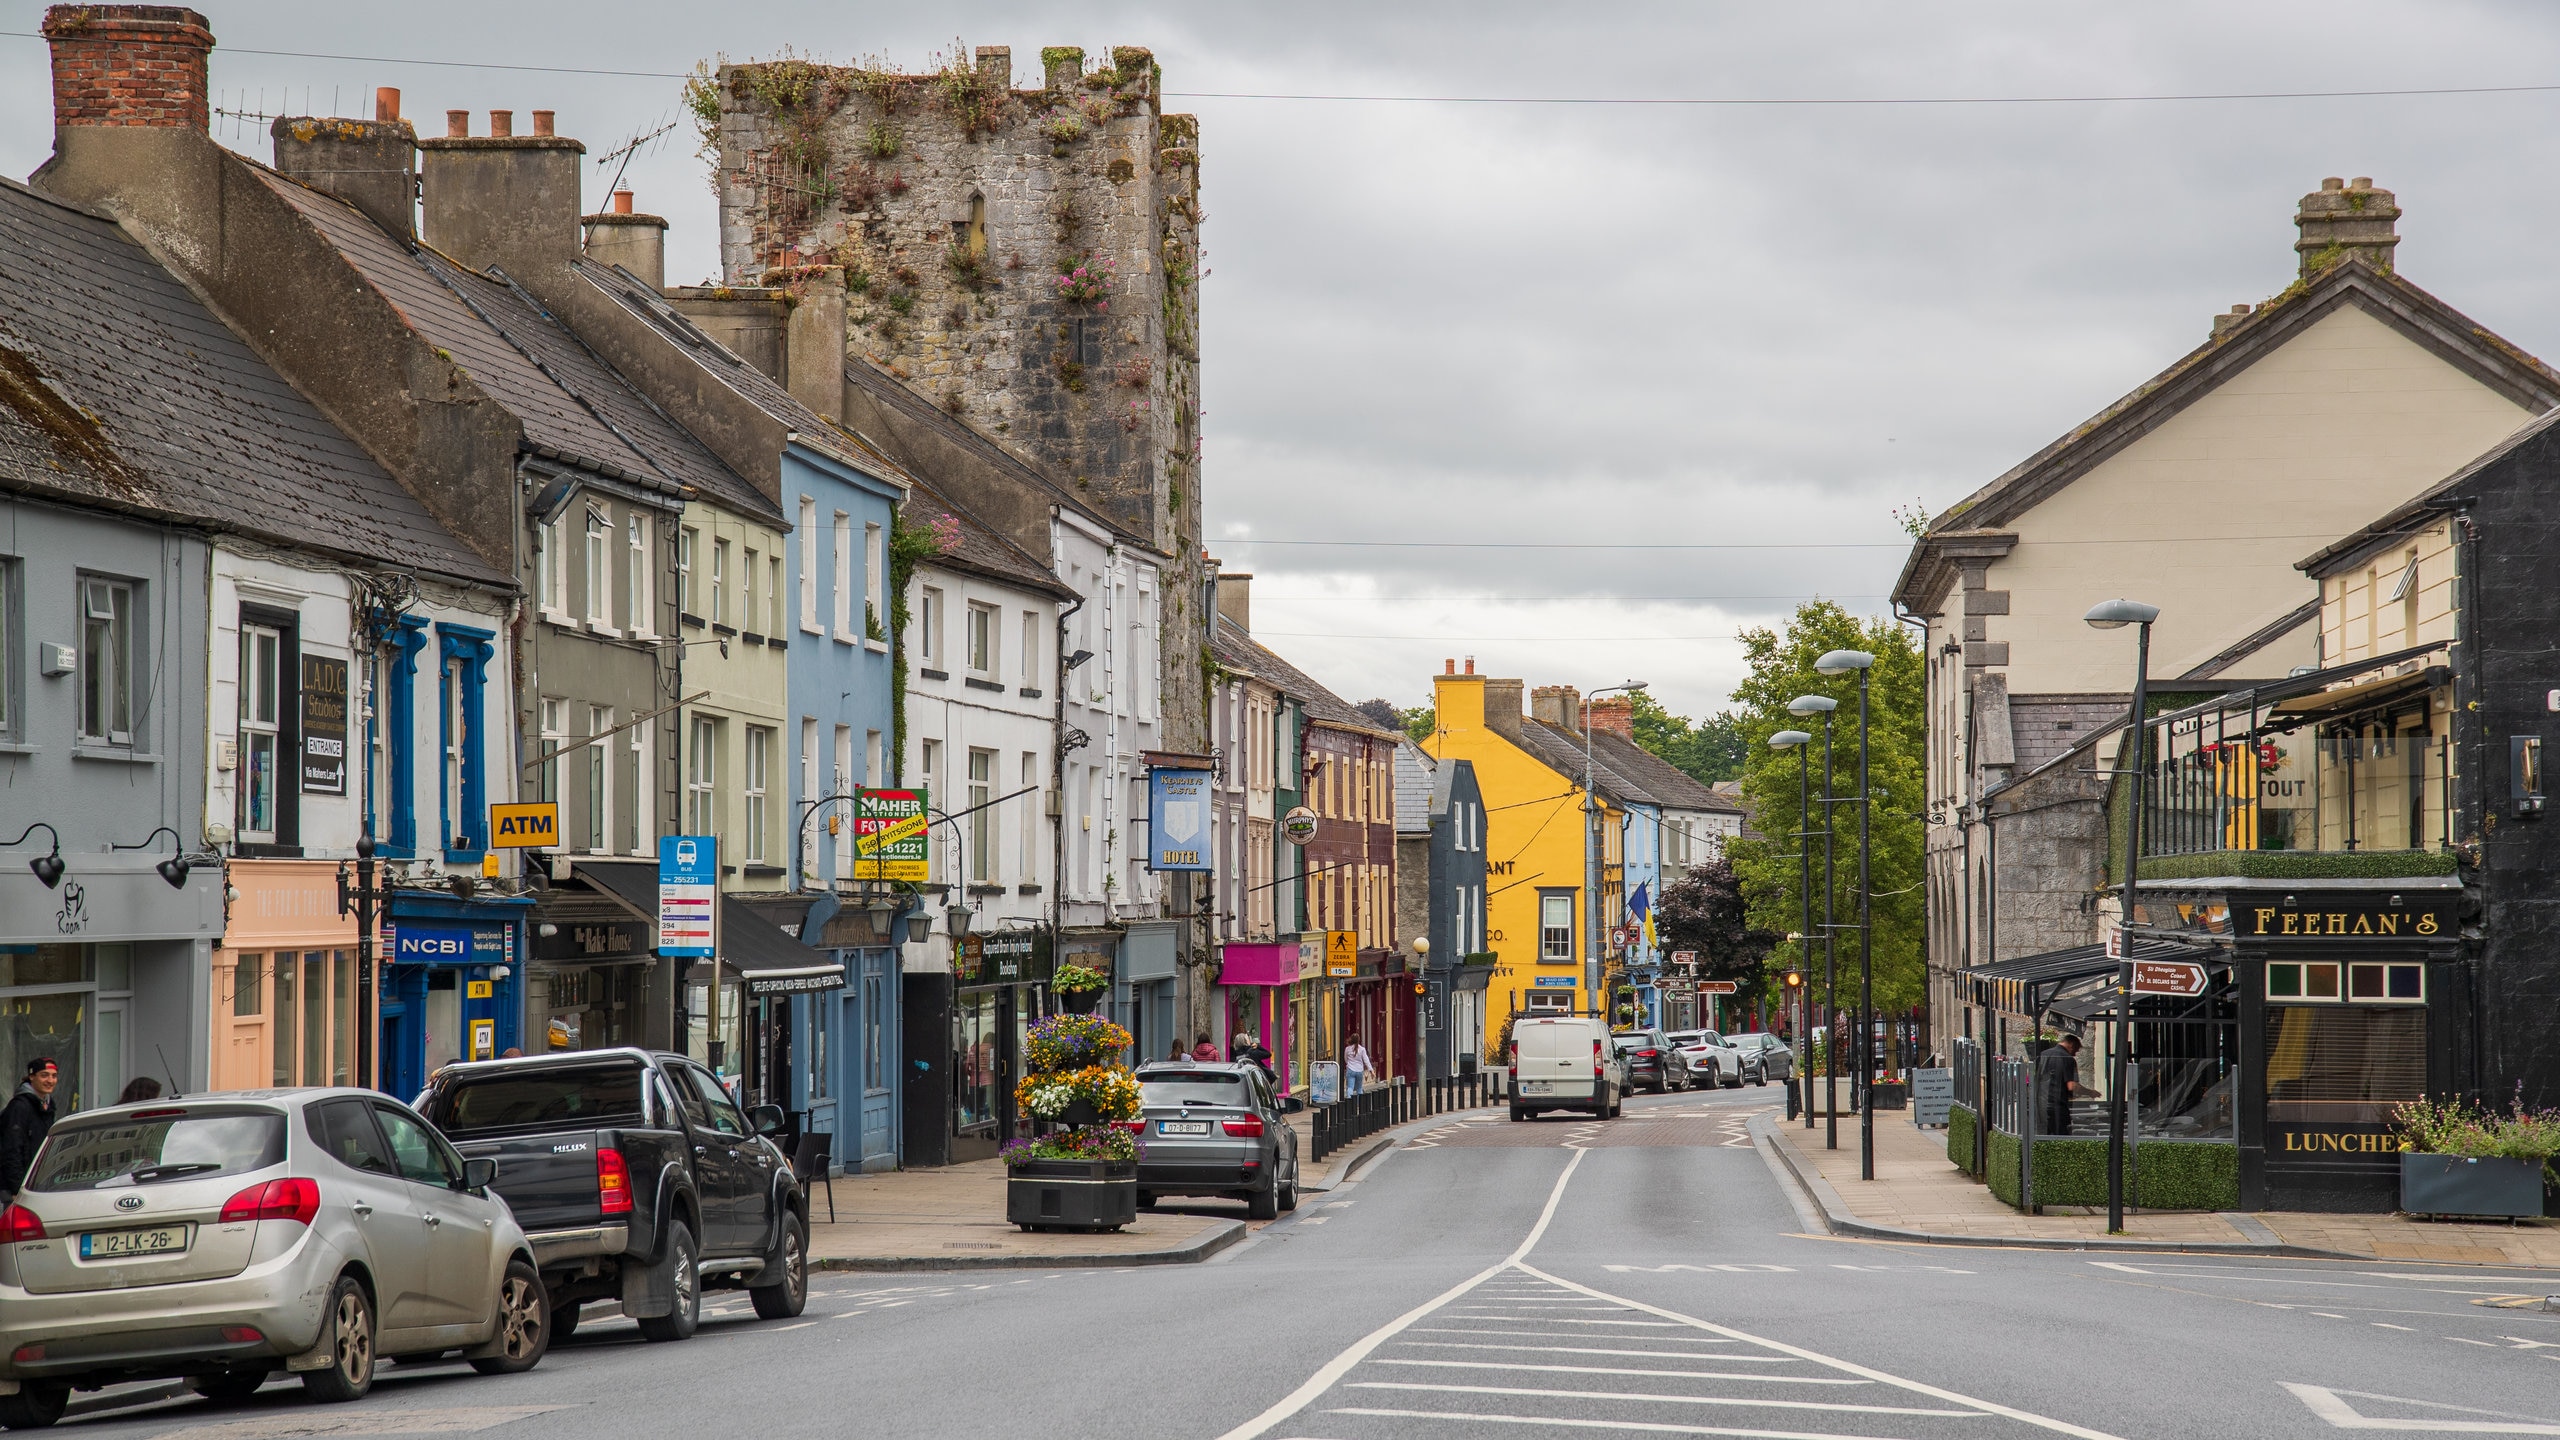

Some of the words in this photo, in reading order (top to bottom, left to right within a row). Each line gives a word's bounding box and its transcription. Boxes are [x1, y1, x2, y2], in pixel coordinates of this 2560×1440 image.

[308, 694, 341, 719] Studios
[309, 739, 341, 755] ENTRANCE
[1166, 785, 1197, 795] CASTLE
[2261, 780, 2305, 797] TOUT
[861, 797, 922, 812] MAHER
[499, 815, 552, 835] ATM
[861, 821, 887, 833] FOR
[862, 818, 924, 850] #SORYITSGONE
[1163, 850, 1200, 865] HOTEL
[56, 910, 80, 934] Room
[82, 906, 89, 931] 4
[2254, 907, 2439, 936] FEEHAN'S
[402, 939, 464, 954] NCBI
[575, 927, 584, 943] The
[586, 927, 606, 953] Bake
[608, 926, 631, 952] House
[983, 939, 999, 958] Acquired
[1000, 939, 1009, 954] Brain
[1000, 960, 1017, 978] Bookshop
[476, 984, 486, 995] ATM
[479, 1032, 489, 1043] ATM
[553, 1142, 587, 1153] HILUX
[121, 1198, 139, 1208] KIA
[106, 1230, 168, 1252] 12-LK-26
